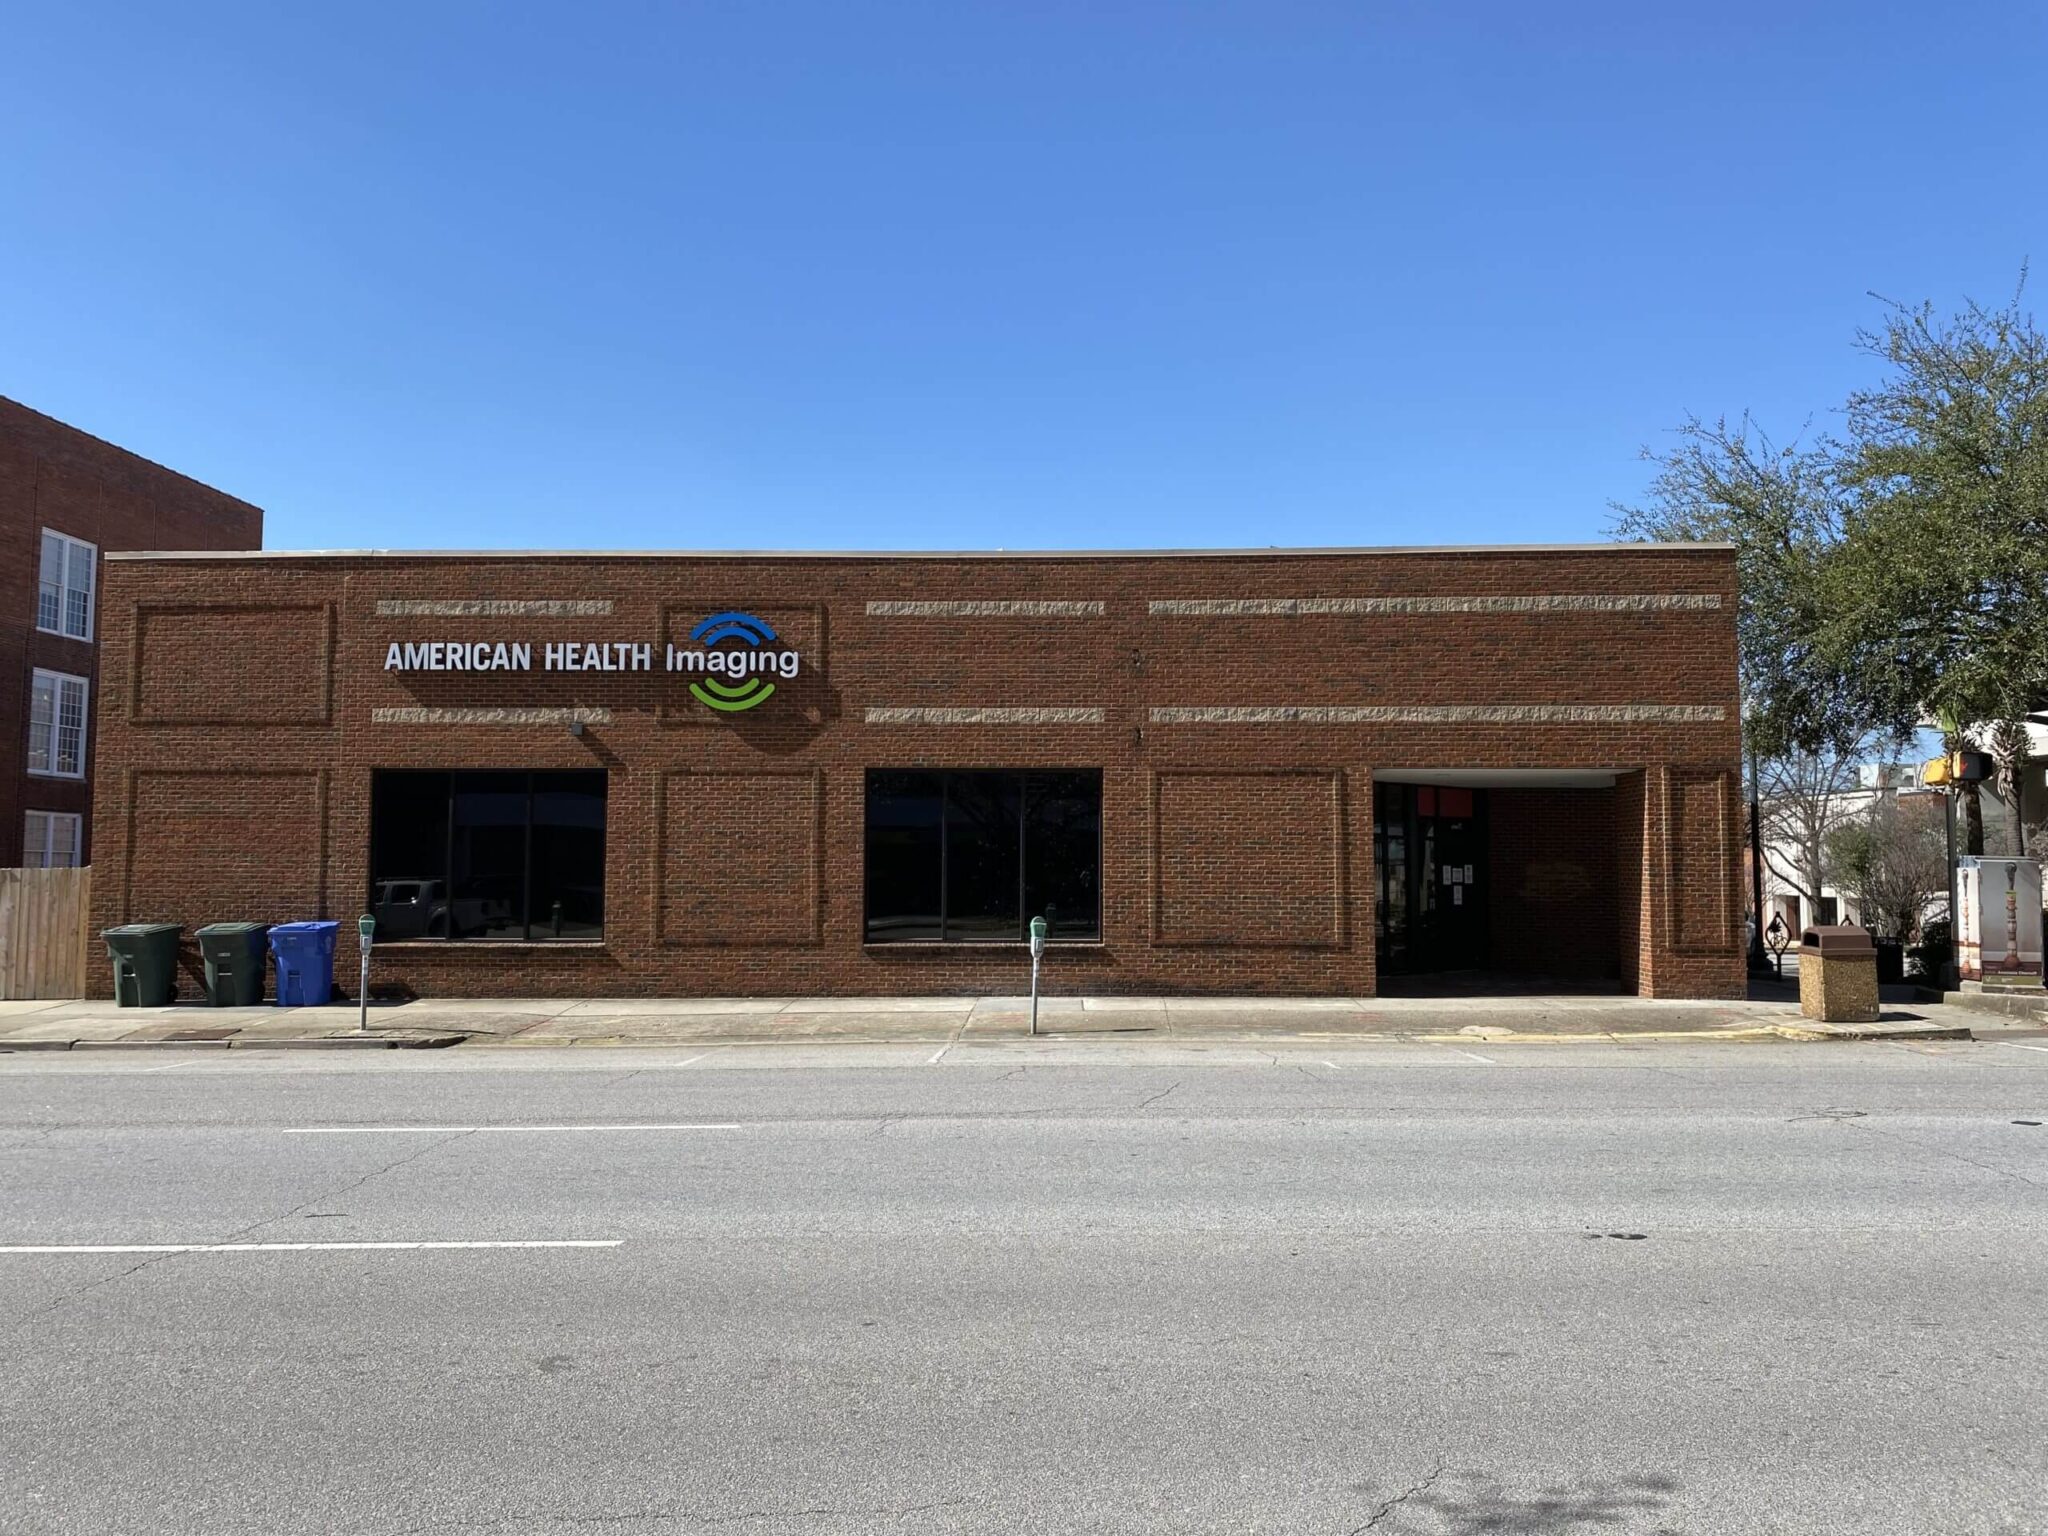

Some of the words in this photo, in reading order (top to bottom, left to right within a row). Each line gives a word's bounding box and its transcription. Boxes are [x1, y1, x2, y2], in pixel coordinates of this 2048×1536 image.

[385, 643, 531, 671] AMERICAN
[545, 643, 651, 671] HEALTH
[666, 643, 799, 678] Imaging
